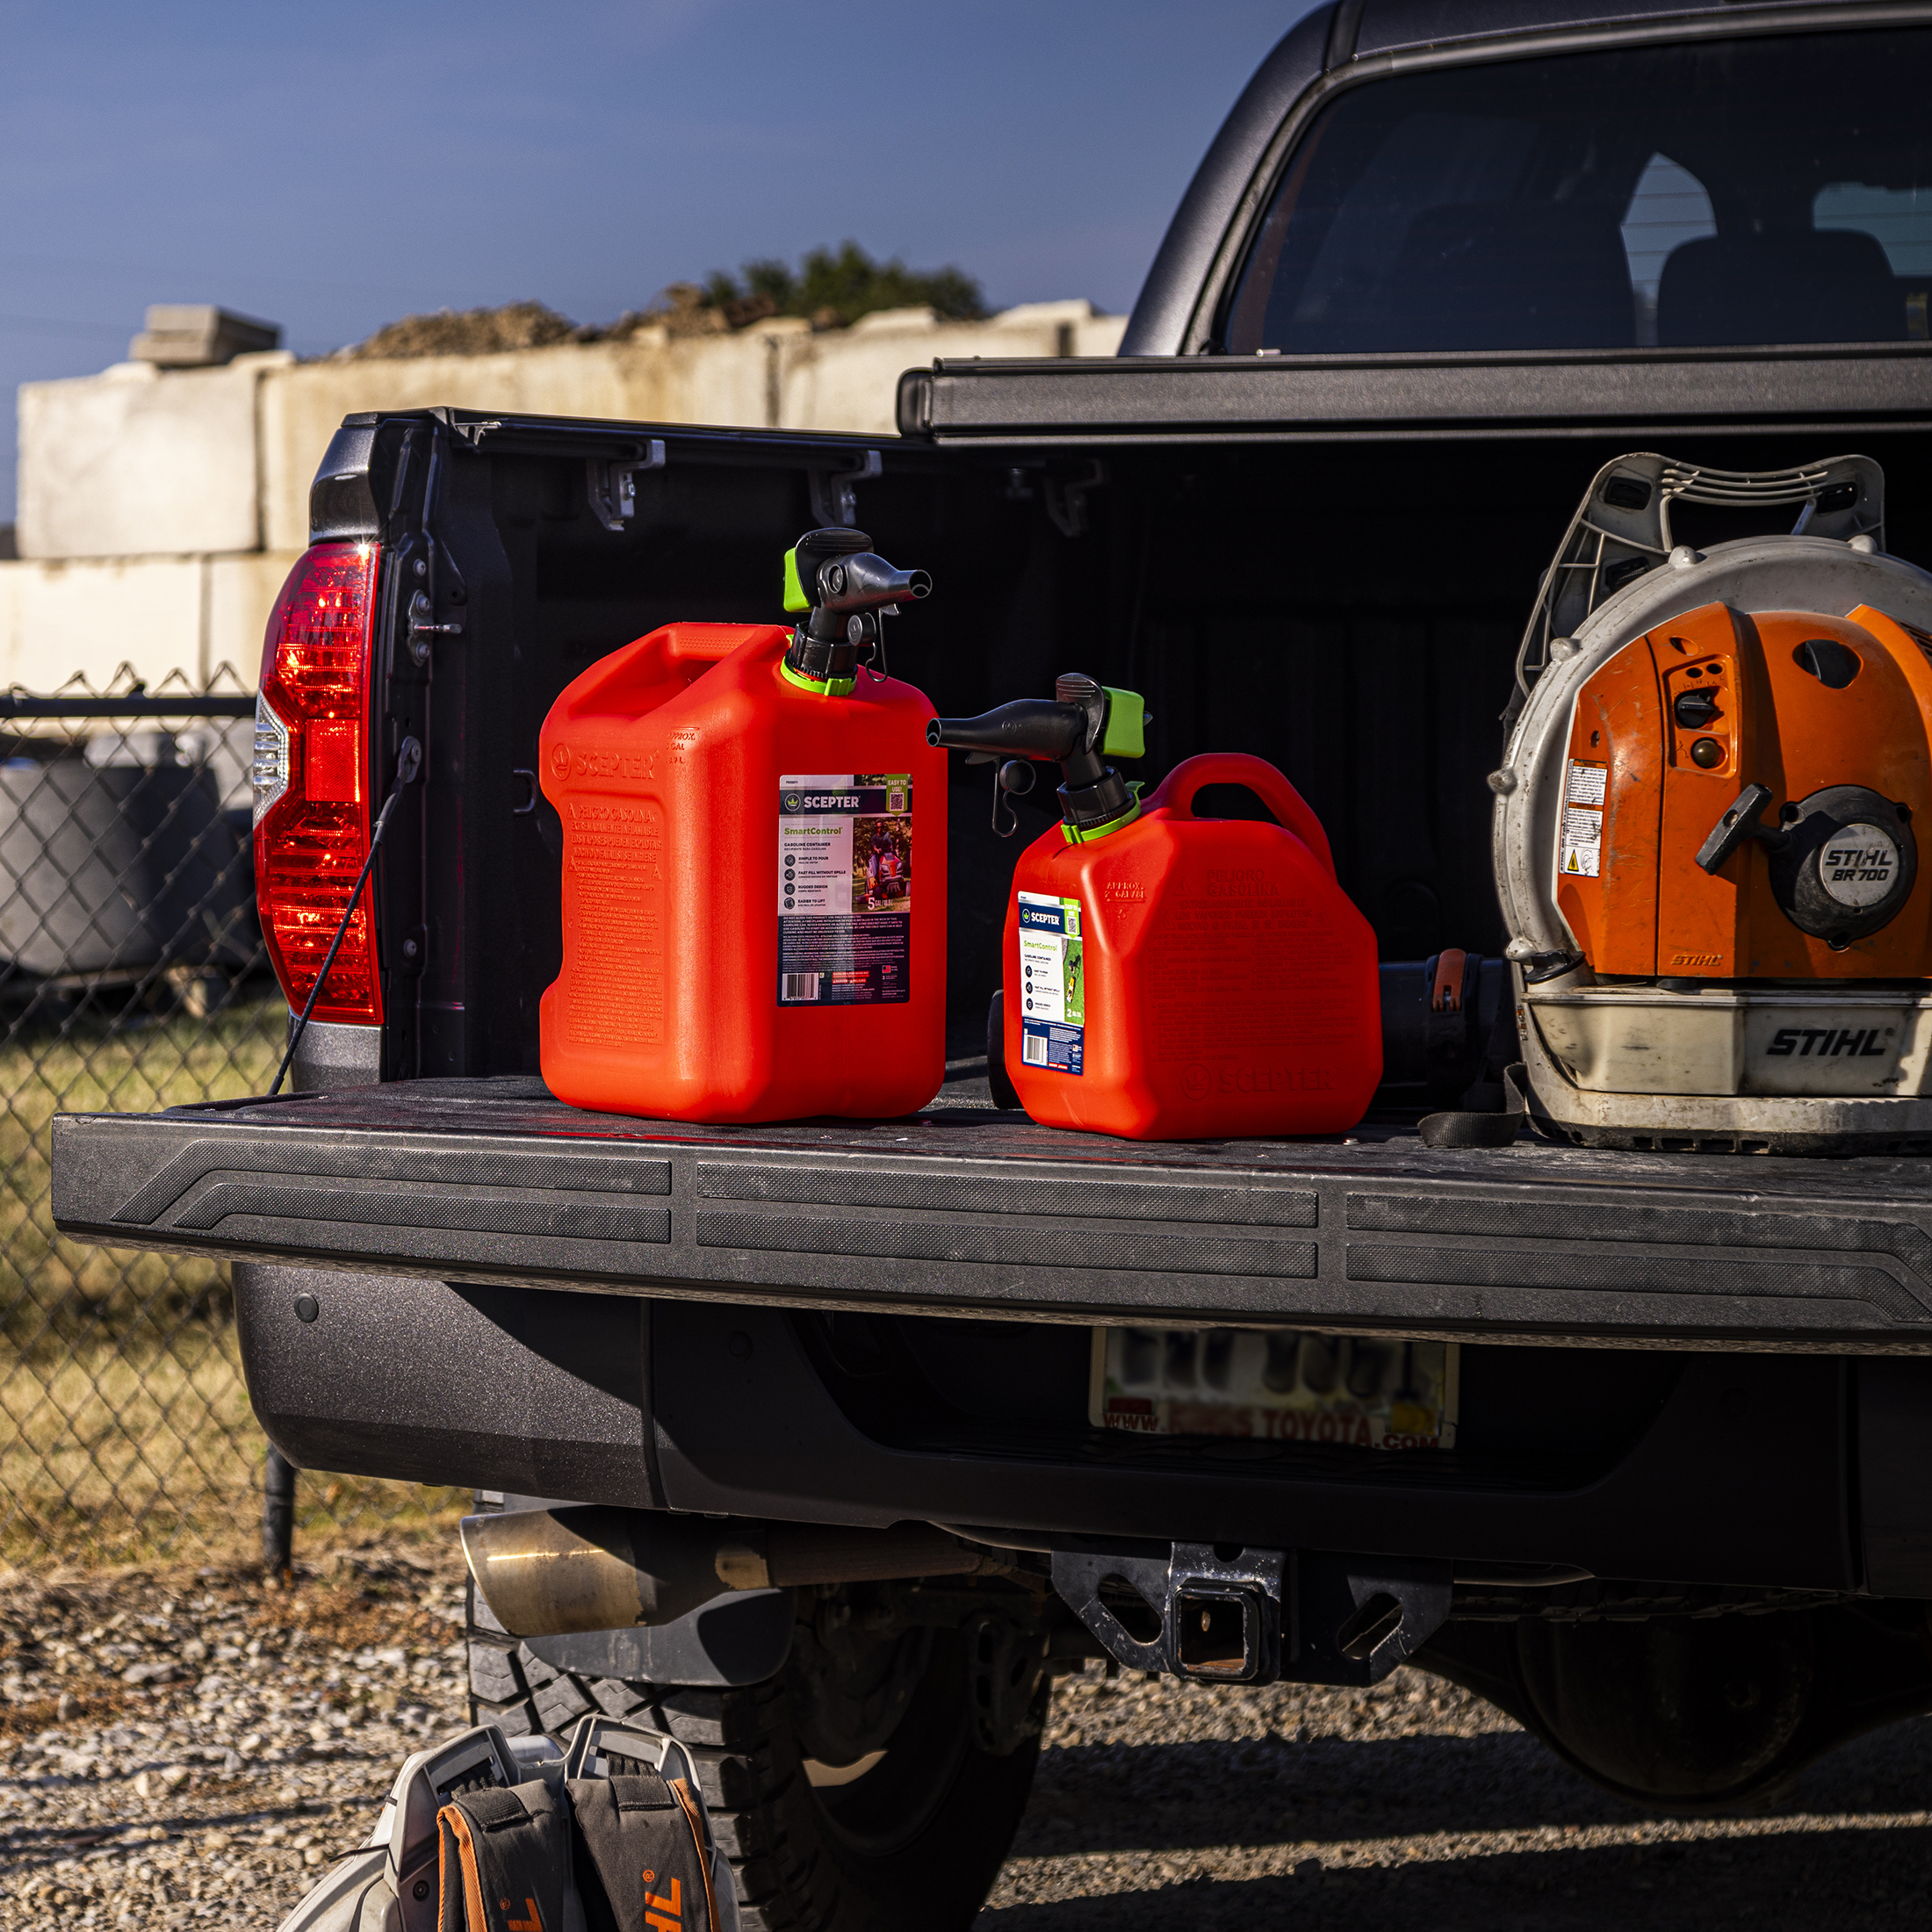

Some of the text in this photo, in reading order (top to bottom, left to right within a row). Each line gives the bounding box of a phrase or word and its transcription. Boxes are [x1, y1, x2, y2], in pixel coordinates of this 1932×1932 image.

[671, 742, 685, 751] GAL
[576, 751, 654, 779] SCEPTER
[804, 796, 860, 809] SCEPTER
[784, 826, 841, 835] SmartControl
[1825, 849, 1893, 867] STIHL
[1832, 869, 1890, 882] BR 700
[1208, 882, 1280, 898] GASOLINA
[867, 897, 876, 911] 5
[1031, 912, 1060, 926] SCEPTER
[1023, 940, 1058, 952] SmartControl
[1670, 954, 1720, 966] STIHL
[1067, 1008, 1072, 1018] 2
[1766, 1028, 1886, 1056] STIHL
[1220, 1065, 1337, 1093] SCEPTER
